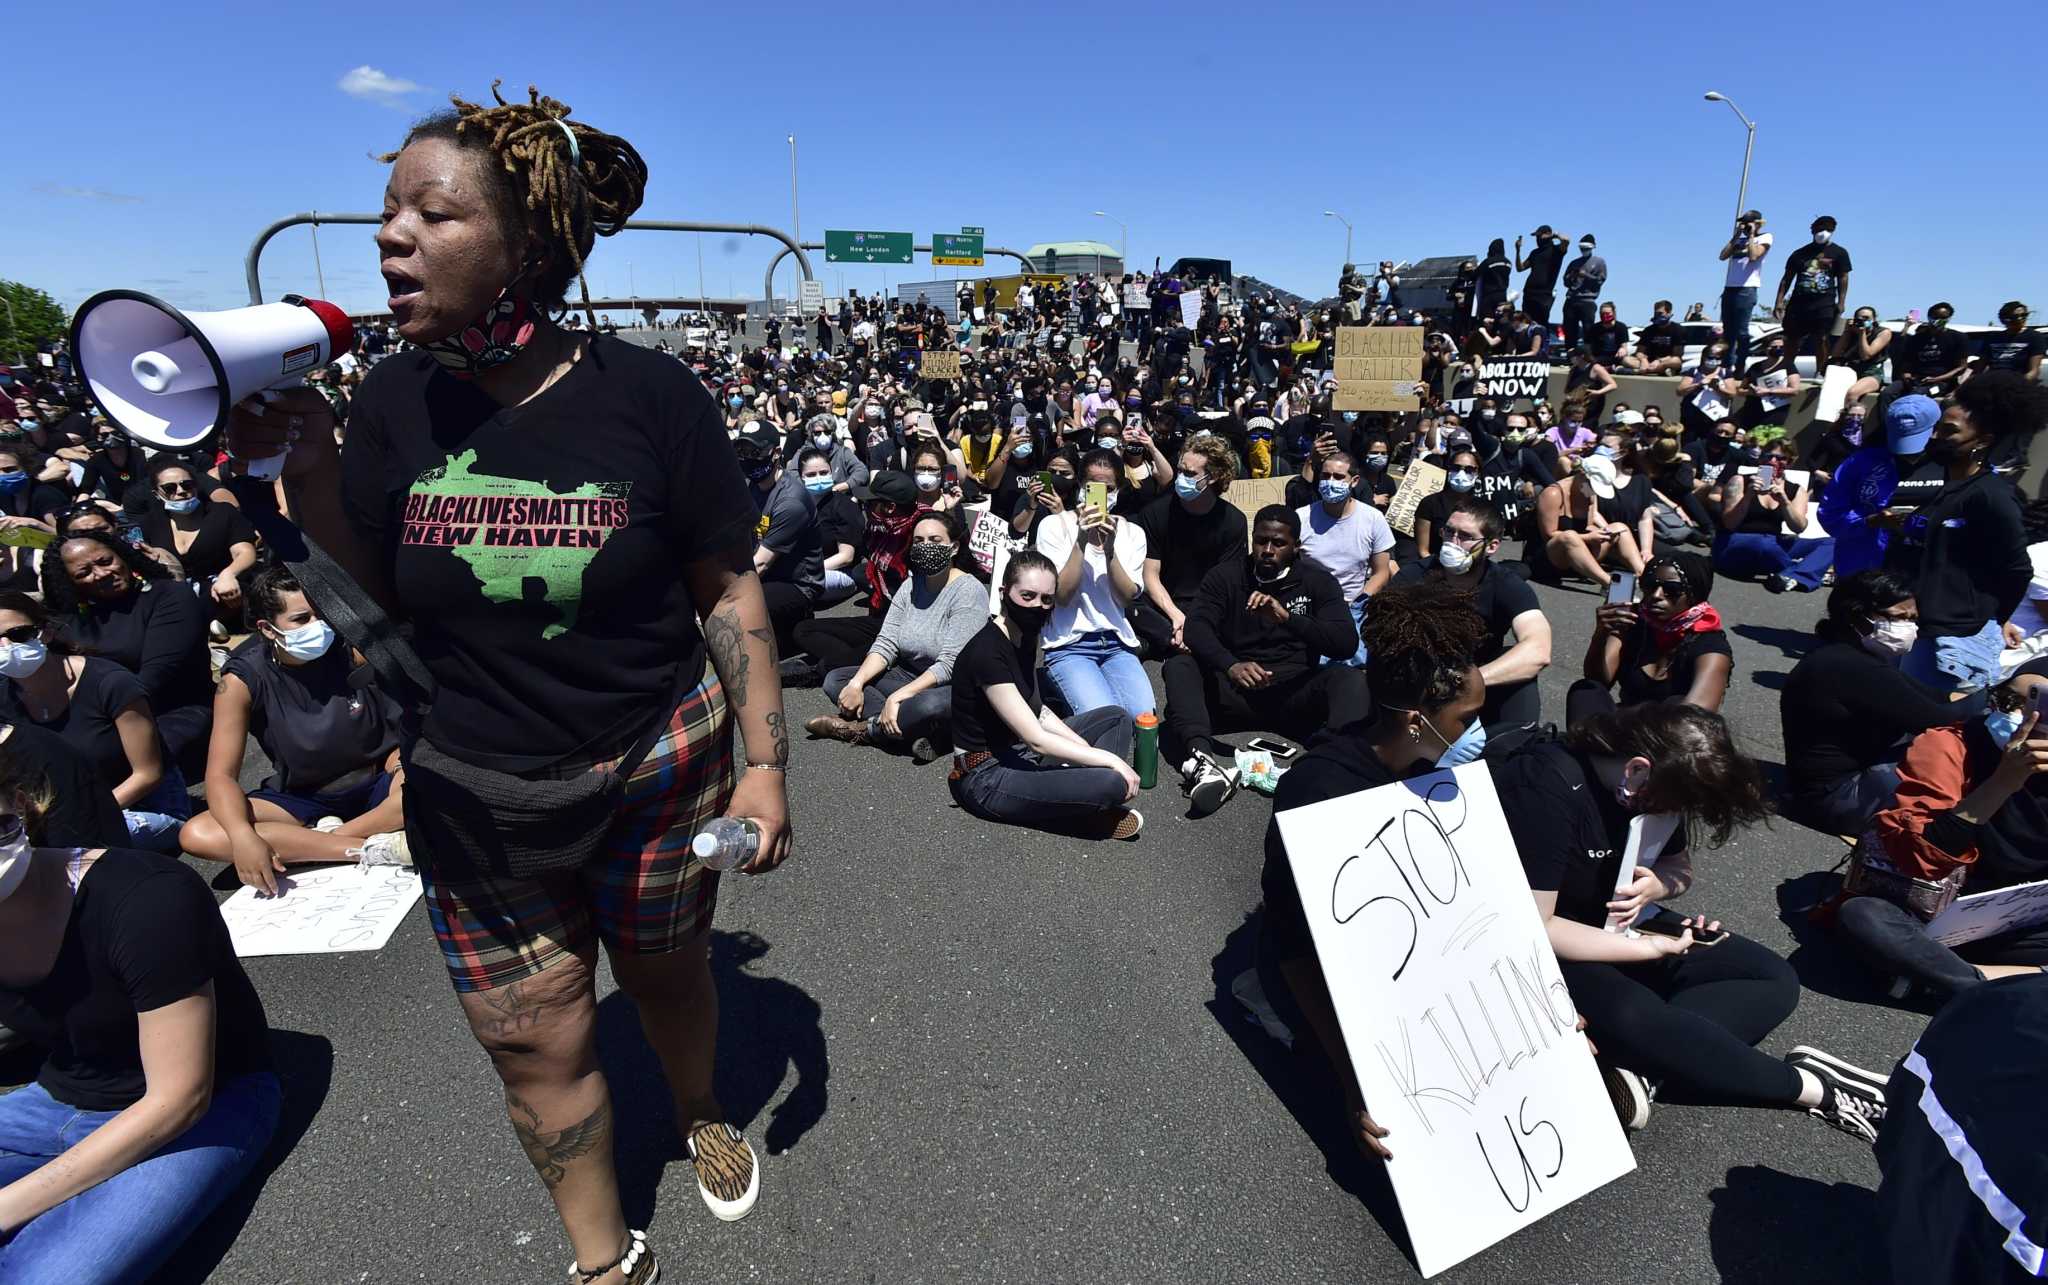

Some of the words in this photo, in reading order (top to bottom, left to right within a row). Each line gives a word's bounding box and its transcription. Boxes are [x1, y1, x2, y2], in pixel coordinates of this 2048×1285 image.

[1341, 331, 1386, 355] BLACK
[927, 352, 954, 360] STOP
[1479, 362, 1550, 379] ABOLITION
[1488, 378, 1544, 396] NOW
[404, 494, 629, 529] BLACKLIVESMATTERS
[403, 524, 479, 546] NEW
[483, 526, 603, 549] HAVEN
[977, 519, 990, 531] 8
[974, 530, 1001, 546] THE
[1331, 780, 1471, 982] STOP
[1374, 940, 1578, 1137] KILLING
[1476, 1096, 1564, 1214] US
